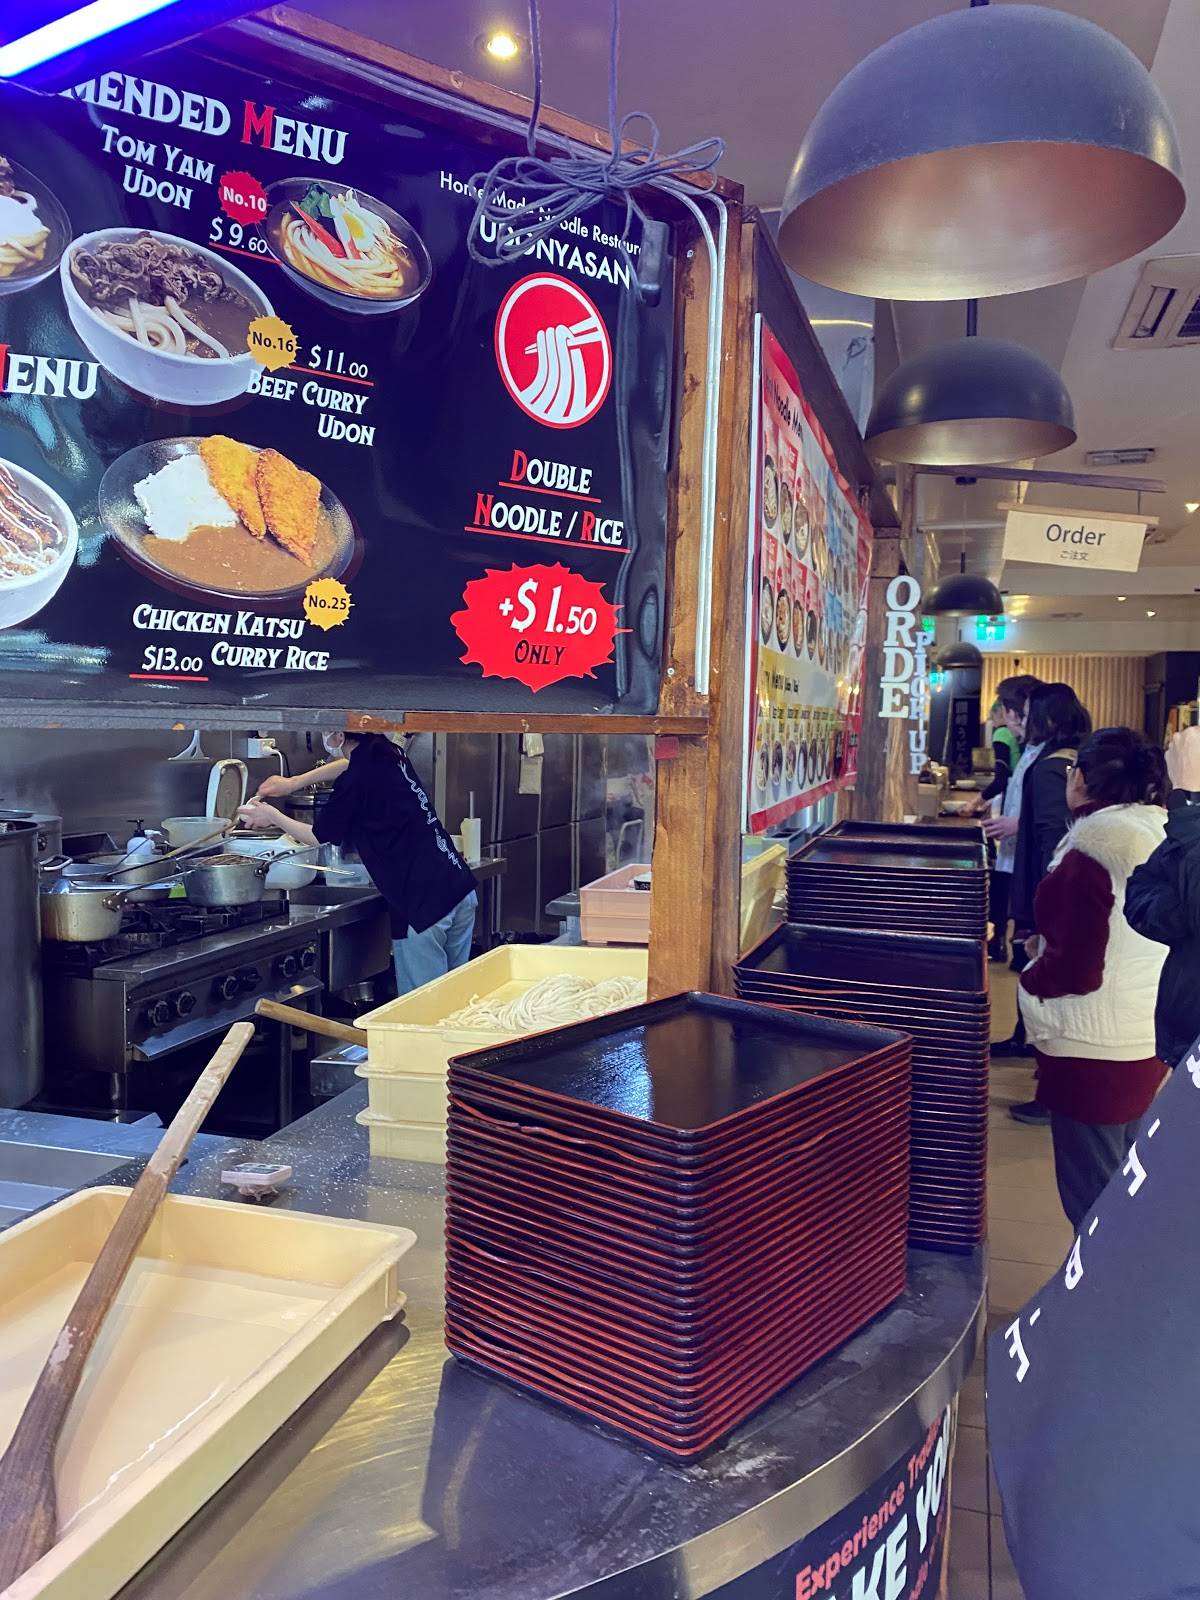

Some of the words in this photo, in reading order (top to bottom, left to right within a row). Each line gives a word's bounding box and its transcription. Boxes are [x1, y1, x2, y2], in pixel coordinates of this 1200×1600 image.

[241, 100, 349, 166] MENU
[101, 123, 157, 167] TOM
[163, 143, 216, 185] YAM
[122, 164, 194, 210] UDON
[223, 186, 267, 212] No.10
[492, 187, 535, 214] Mad
[592, 224, 642, 256] Restur
[252, 331, 294, 353] No.16
[308, 344, 369, 379] $11.00
[246, 368, 298, 401] BEEF
[302, 380, 369, 415] CURRY
[317, 412, 376, 447] UDON
[509, 449, 593, 495] DOUBLE
[473, 492, 563, 537] NOODLE
[580, 510, 624, 546] RICE
[1046, 523, 1106, 546] Order
[132, 603, 232, 635] CHICKEN
[233, 610, 306, 640] KATSU
[308, 595, 347, 611] No.25
[142, 644, 204, 672] $13.00
[210, 641, 284, 670] CURRY
[284, 645, 330, 671] RICE
[514, 639, 566, 666] ONLY
[878, 575, 921, 718] ORDE
[795, 1481, 905, 1600] Experience
[825, 1513, 908, 1600] KE
